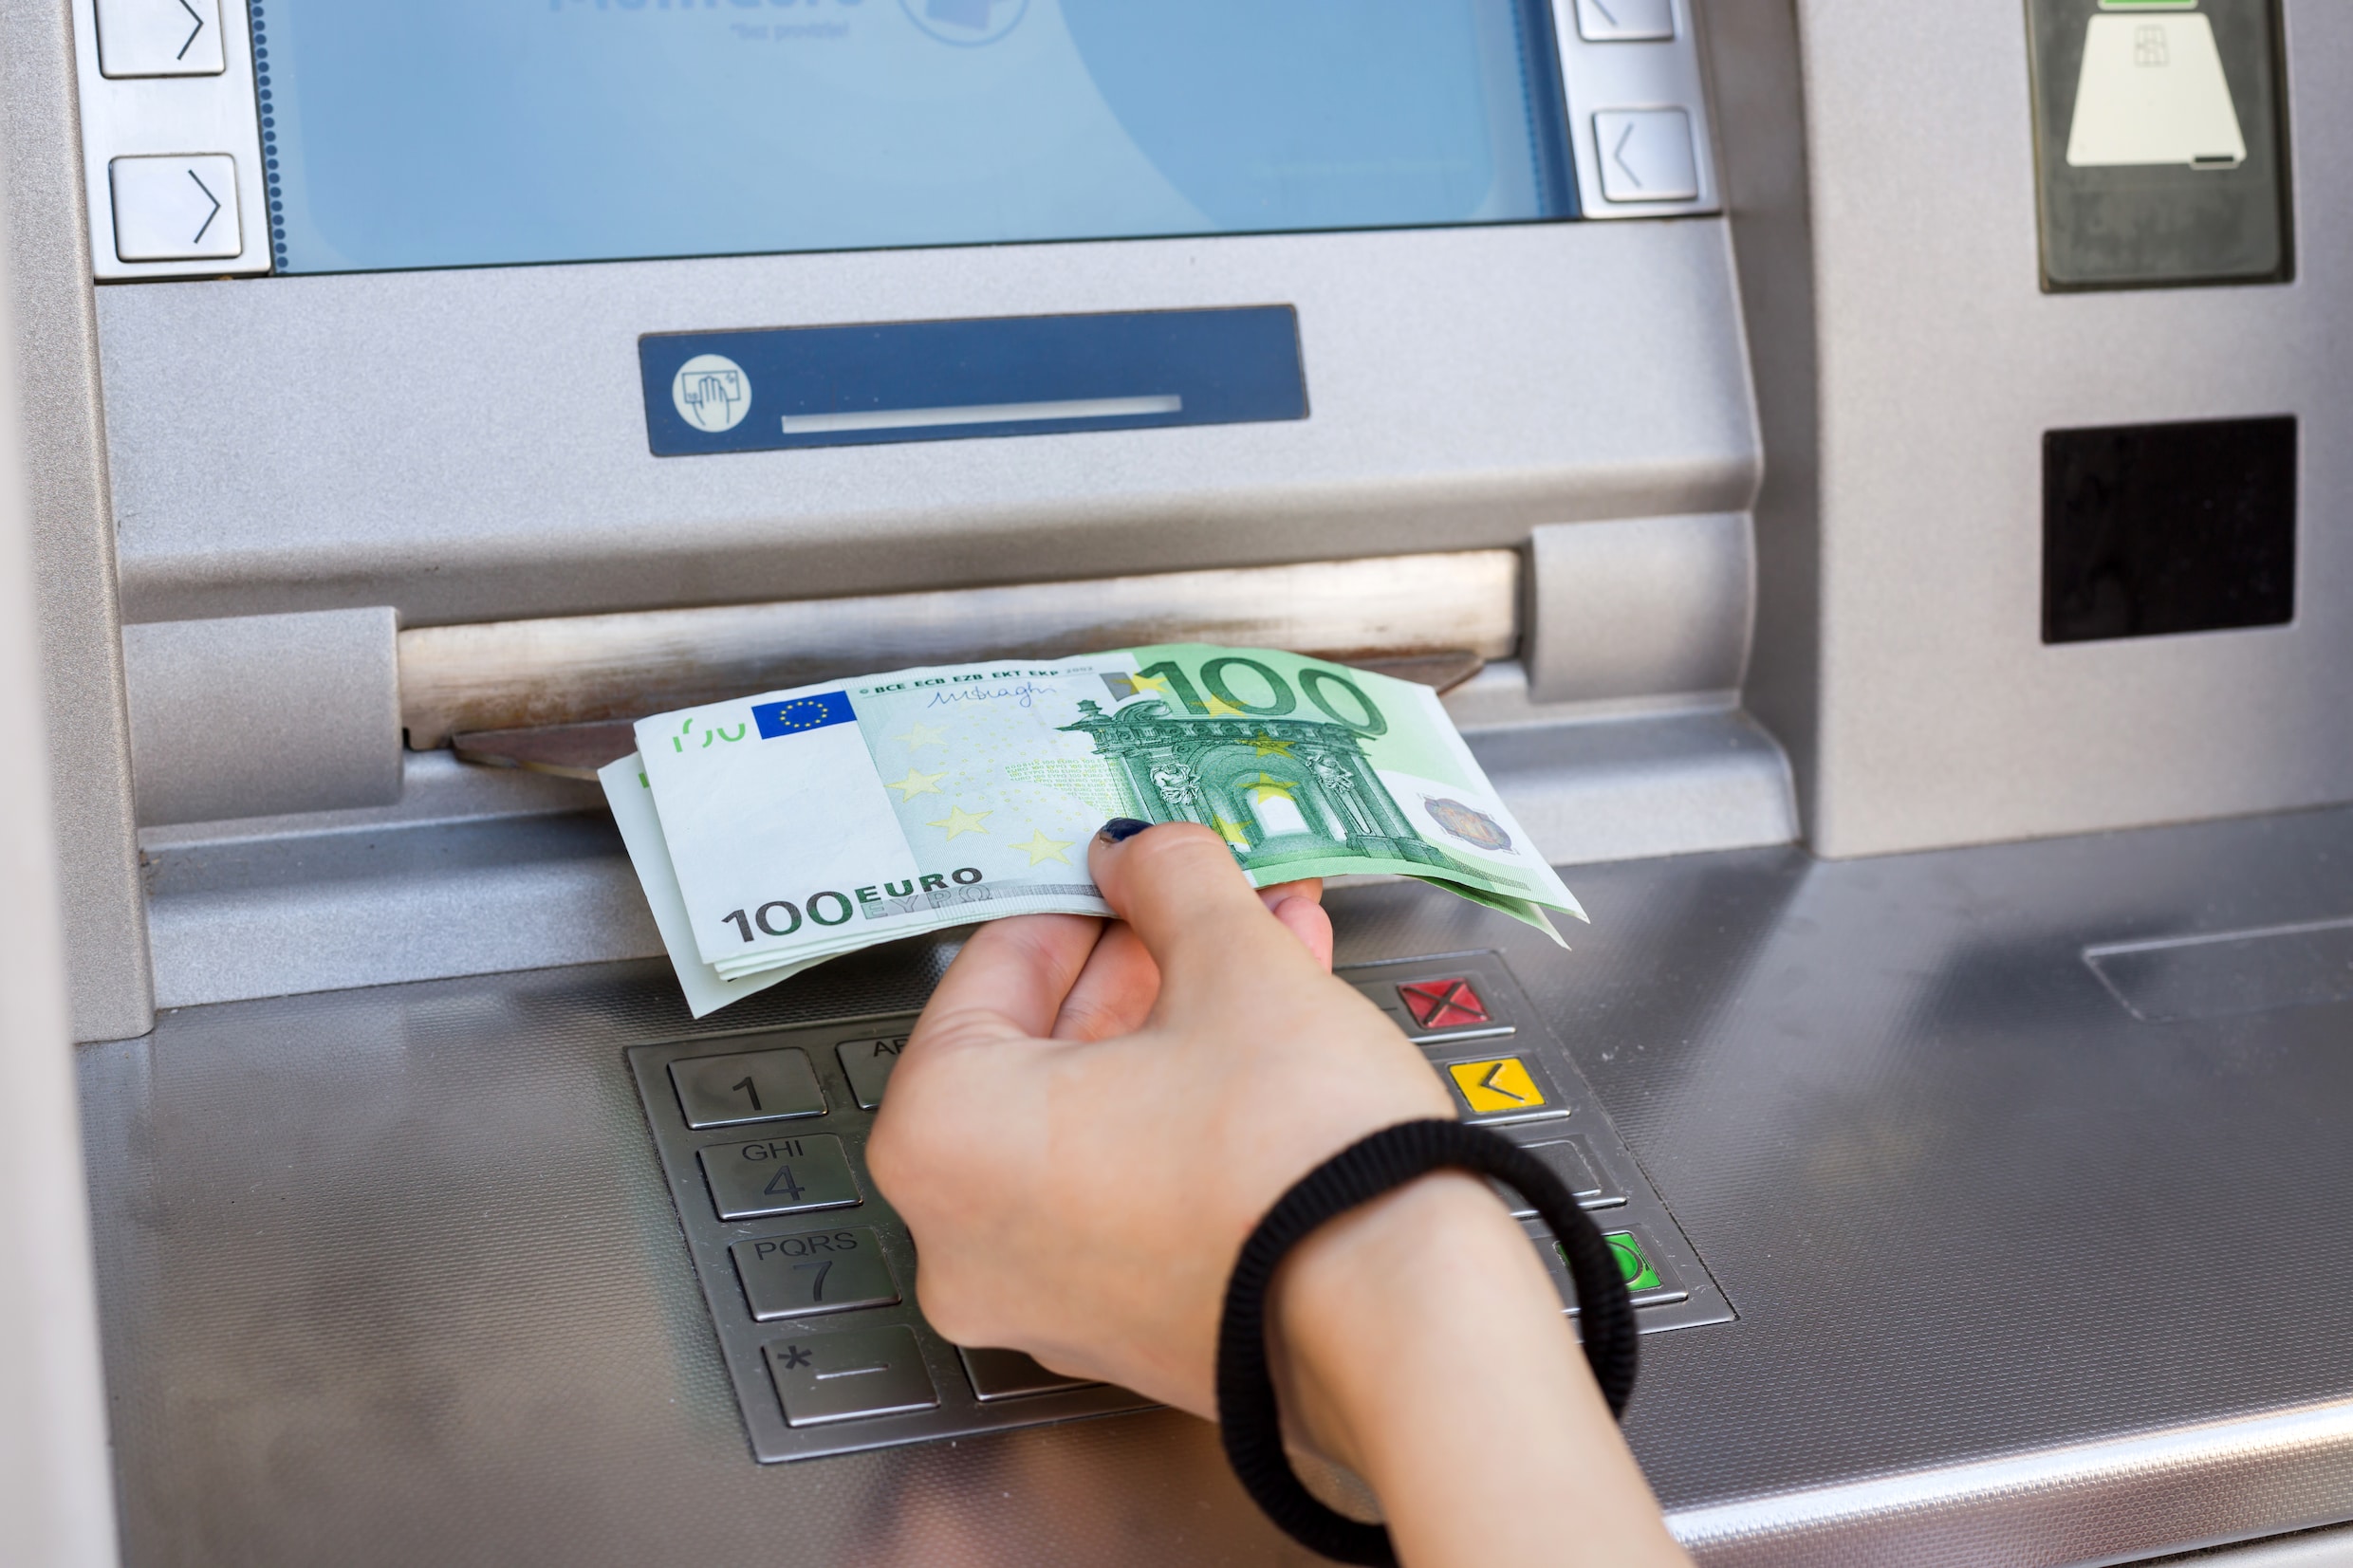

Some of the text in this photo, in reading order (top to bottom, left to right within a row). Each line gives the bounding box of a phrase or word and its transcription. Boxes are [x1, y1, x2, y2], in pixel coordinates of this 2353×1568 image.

[874, 682, 908, 694] BCE
[914, 677, 947, 688] ECB
[953, 673, 984, 683] EZB
[991, 670, 1022, 679] EKT
[1134, 656, 1388, 736] 100
[721, 867, 983, 943] 100 EURO
[732, 1076, 764, 1112] 1
[741, 1140, 804, 1163] GHI
[763, 1165, 806, 1201] 4
[753, 1232, 859, 1261] PQRS
[792, 1260, 834, 1302] 7
